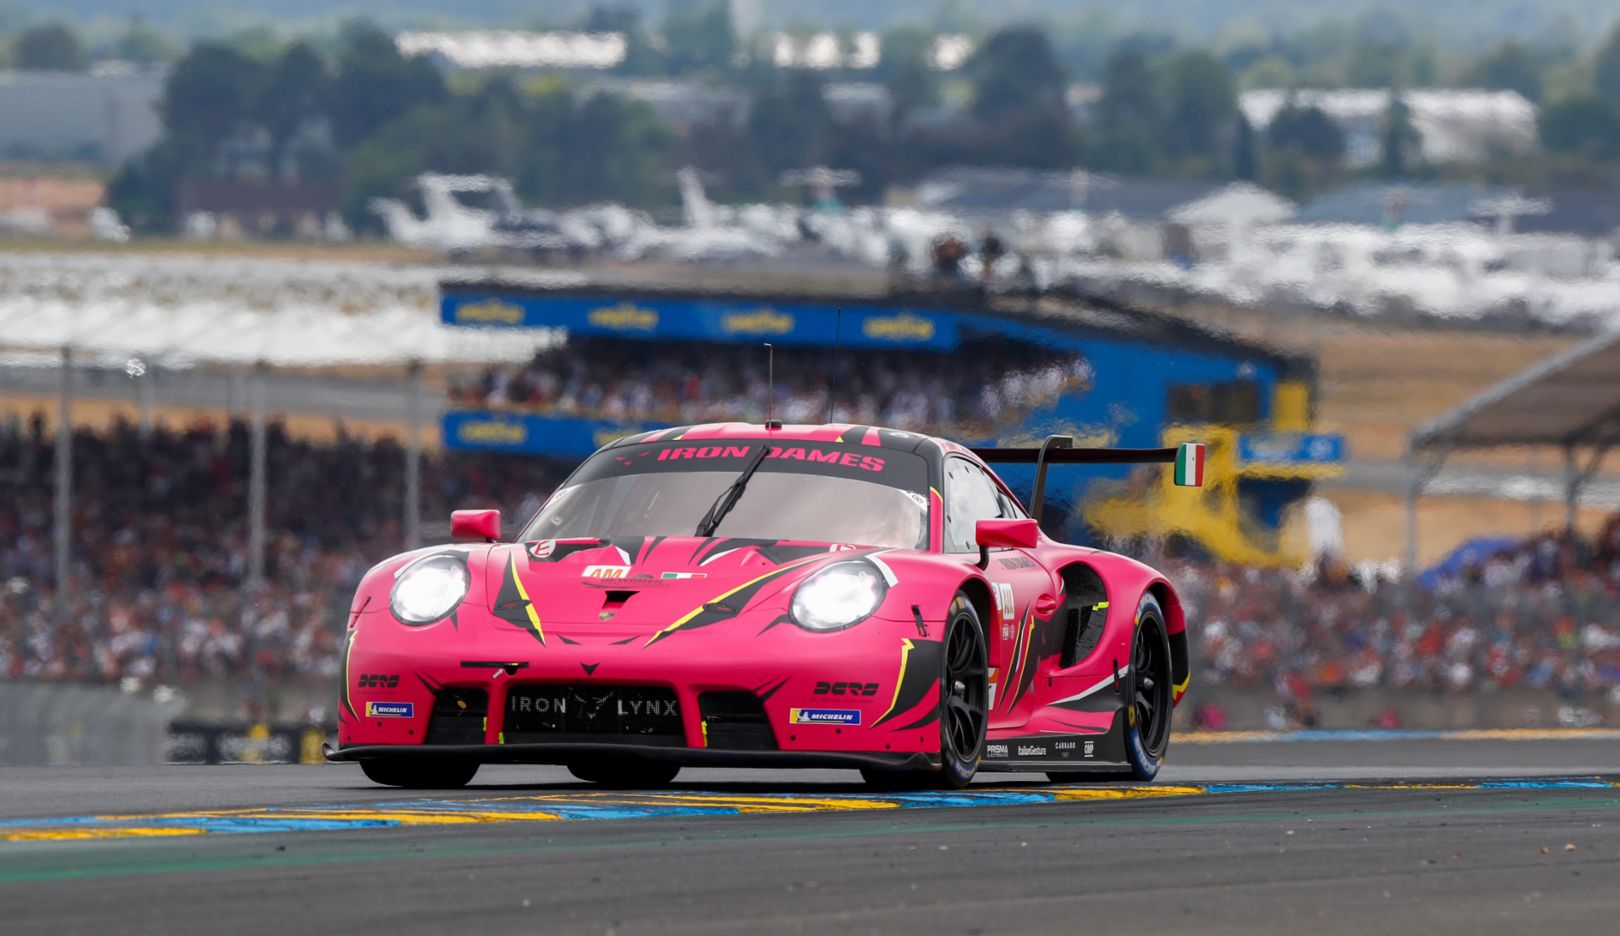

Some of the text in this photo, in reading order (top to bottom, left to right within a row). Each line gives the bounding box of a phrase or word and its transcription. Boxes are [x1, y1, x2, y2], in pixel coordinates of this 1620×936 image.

[657, 446, 885, 472] IRON DAMES
[511, 696, 678, 716] IRON LYNX
[810, 713, 853, 721] MICHELIN
[986, 745, 1008, 753] PRISMA
